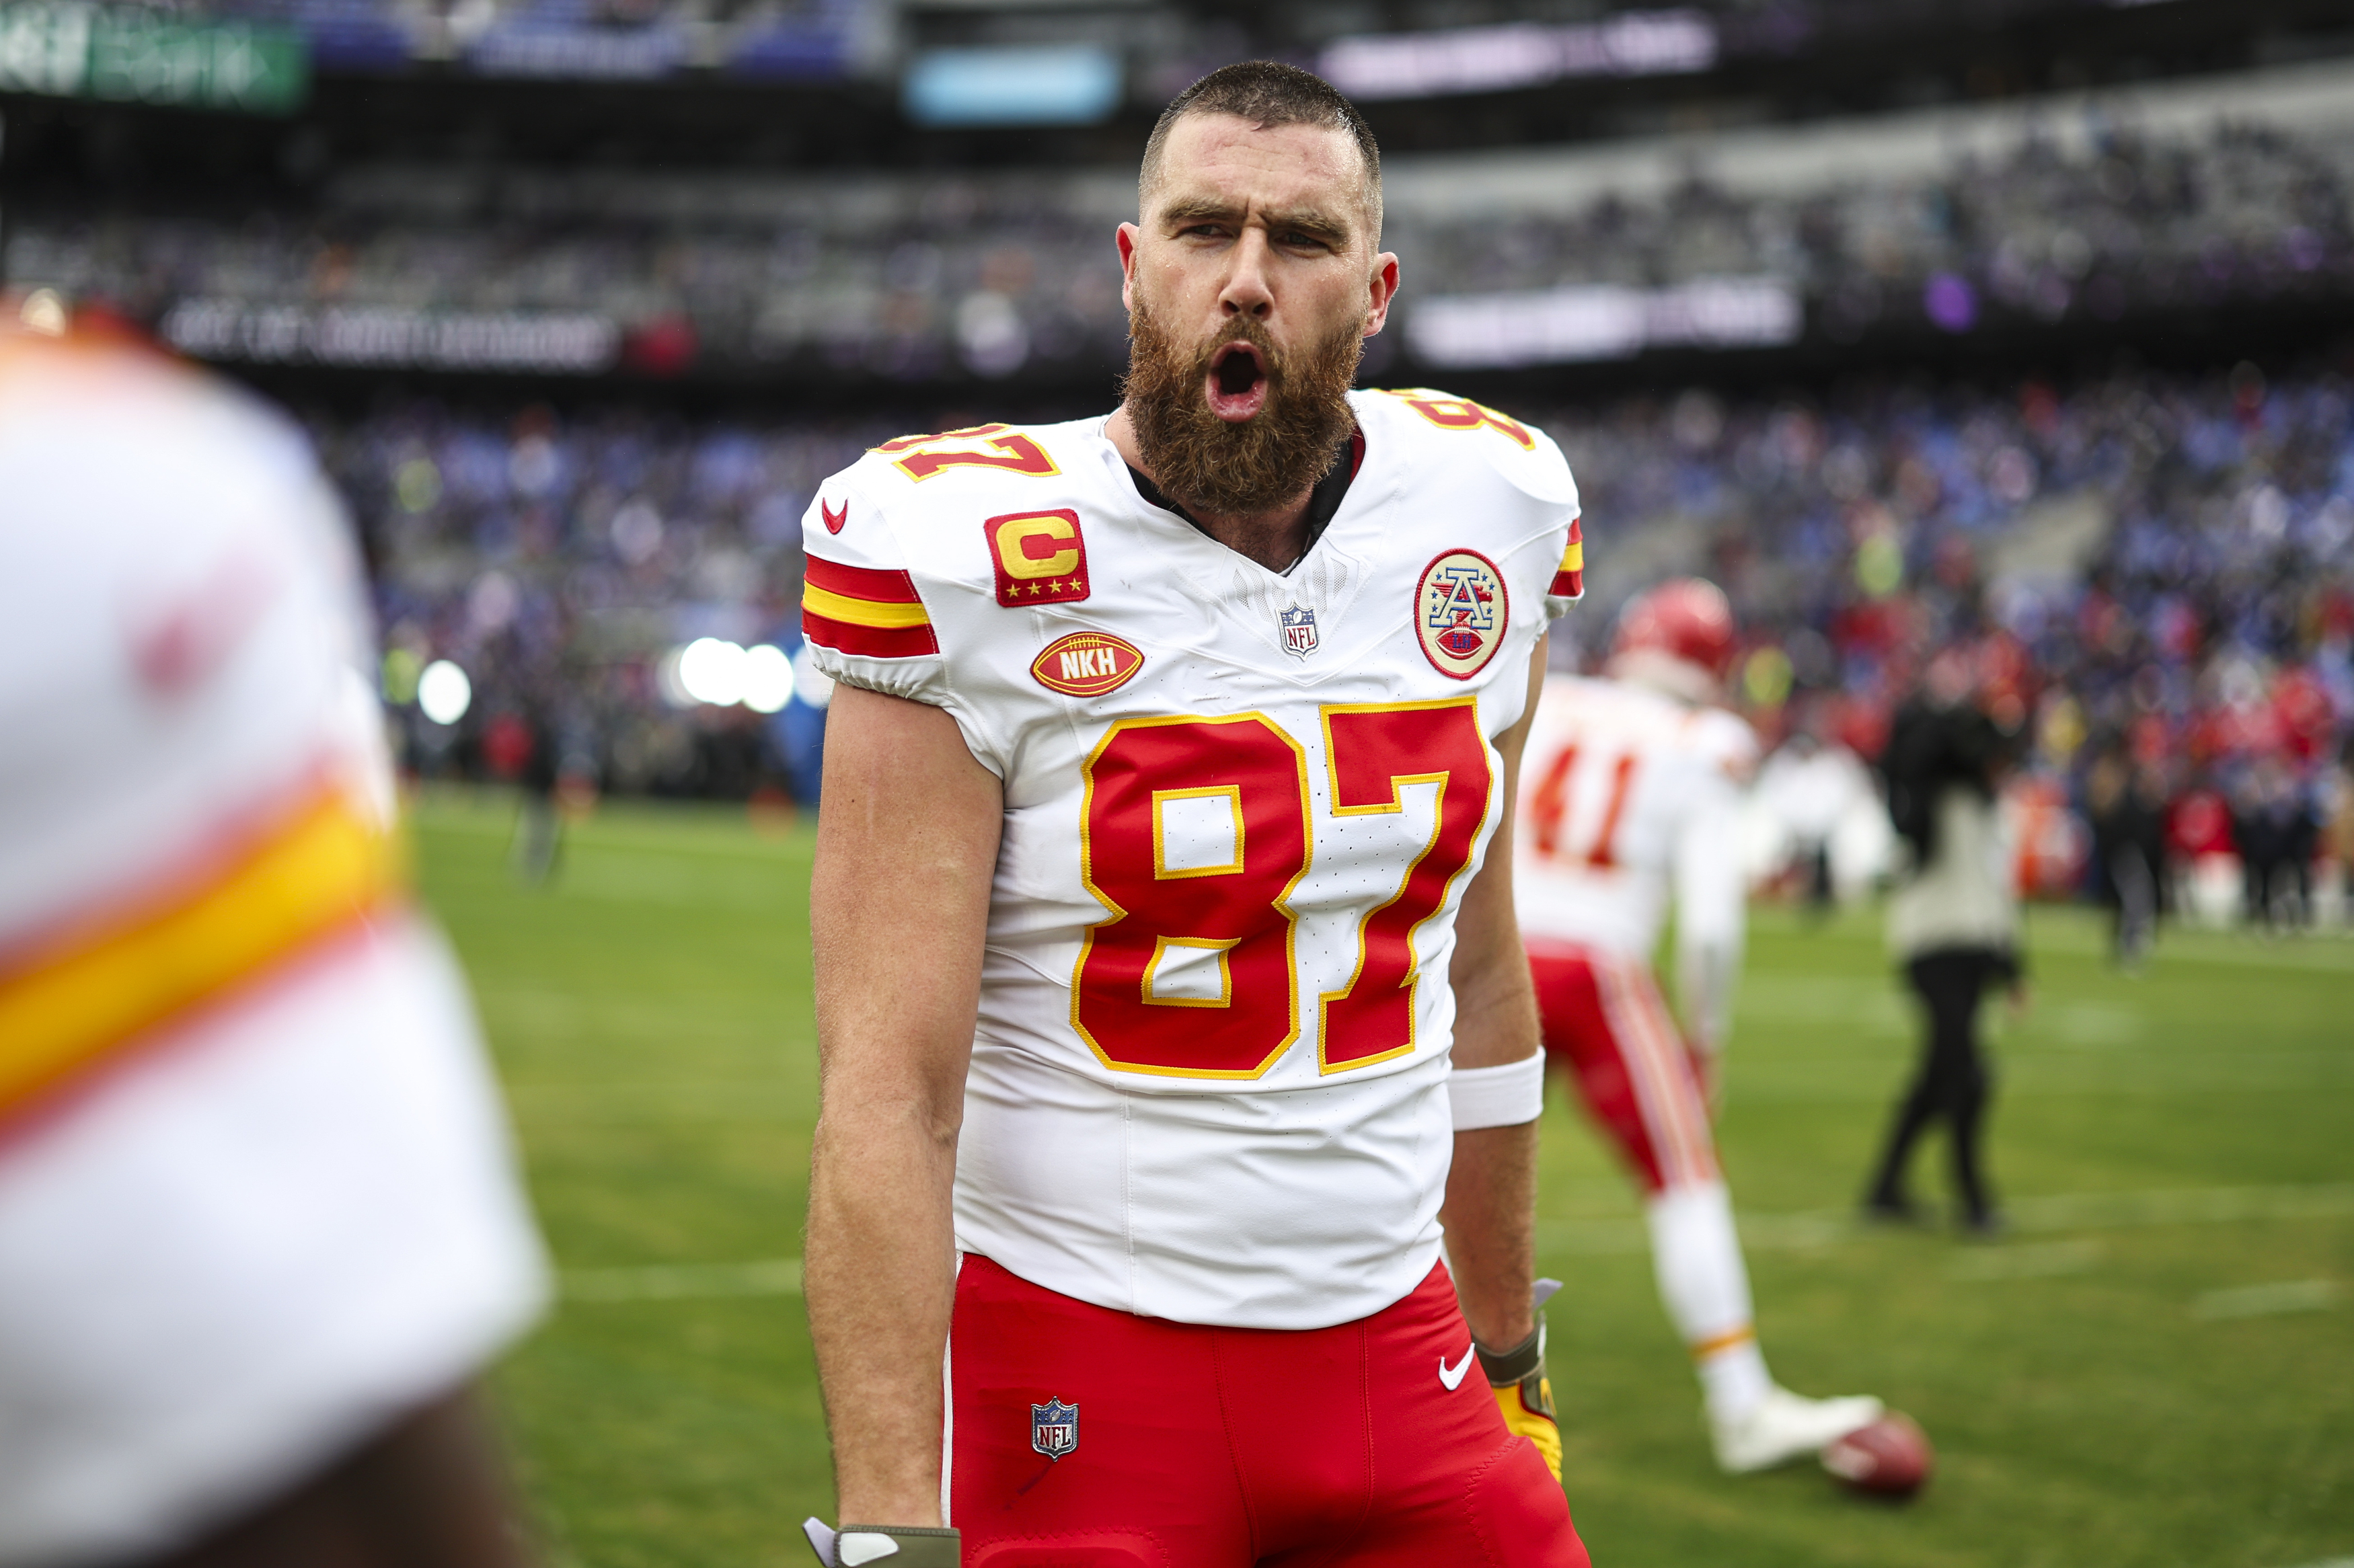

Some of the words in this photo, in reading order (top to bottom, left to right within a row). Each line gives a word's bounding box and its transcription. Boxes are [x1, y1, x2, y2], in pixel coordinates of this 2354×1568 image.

[995, 516, 1079, 580] C
[1429, 567, 1492, 630] A
[1287, 627, 1315, 650] NFL
[1452, 634, 1472, 649] LH
[1059, 647, 1118, 680] NKH
[1069, 695, 1494, 1081] 87
[1038, 1426, 1071, 1450] NFL
